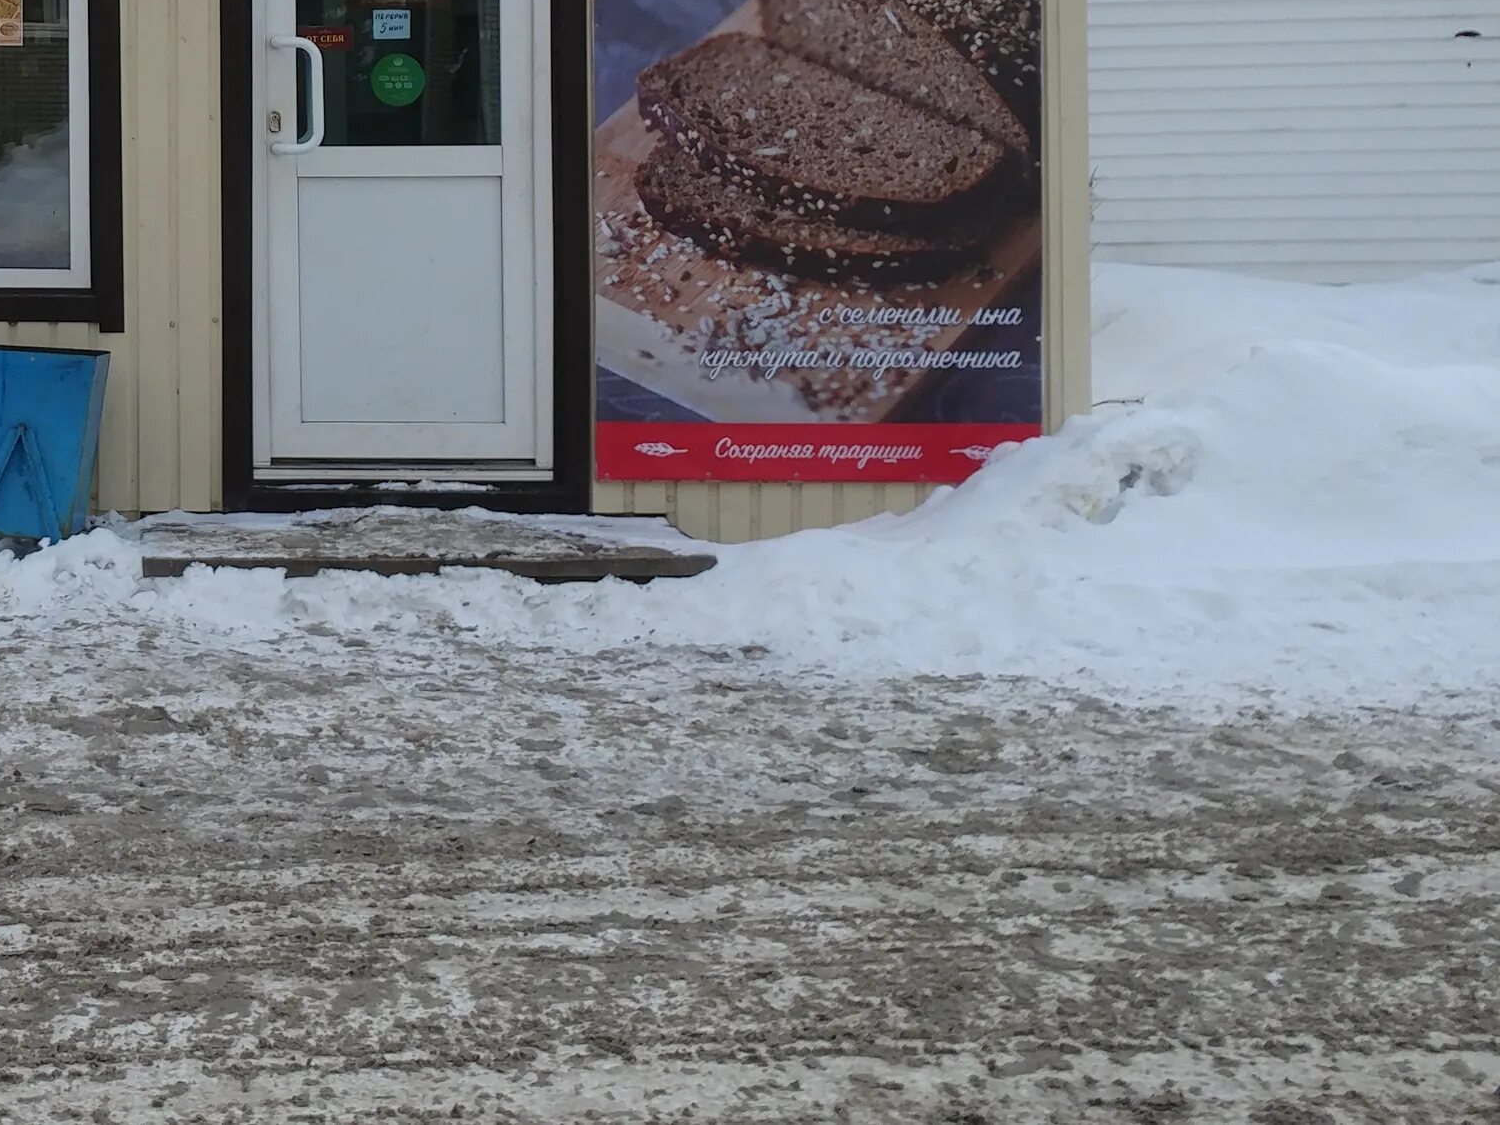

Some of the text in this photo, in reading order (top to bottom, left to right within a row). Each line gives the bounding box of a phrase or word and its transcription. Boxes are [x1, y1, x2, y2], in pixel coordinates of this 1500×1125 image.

[379, 23, 387, 34] 5
[320, 35, 345, 43] СЕБЯ
[819, 307, 1023, 326] с семенами льна
[700, 348, 1022, 381] кунжута и подсолнечника
[714, 436, 923, 469] Сохраняя традиции
